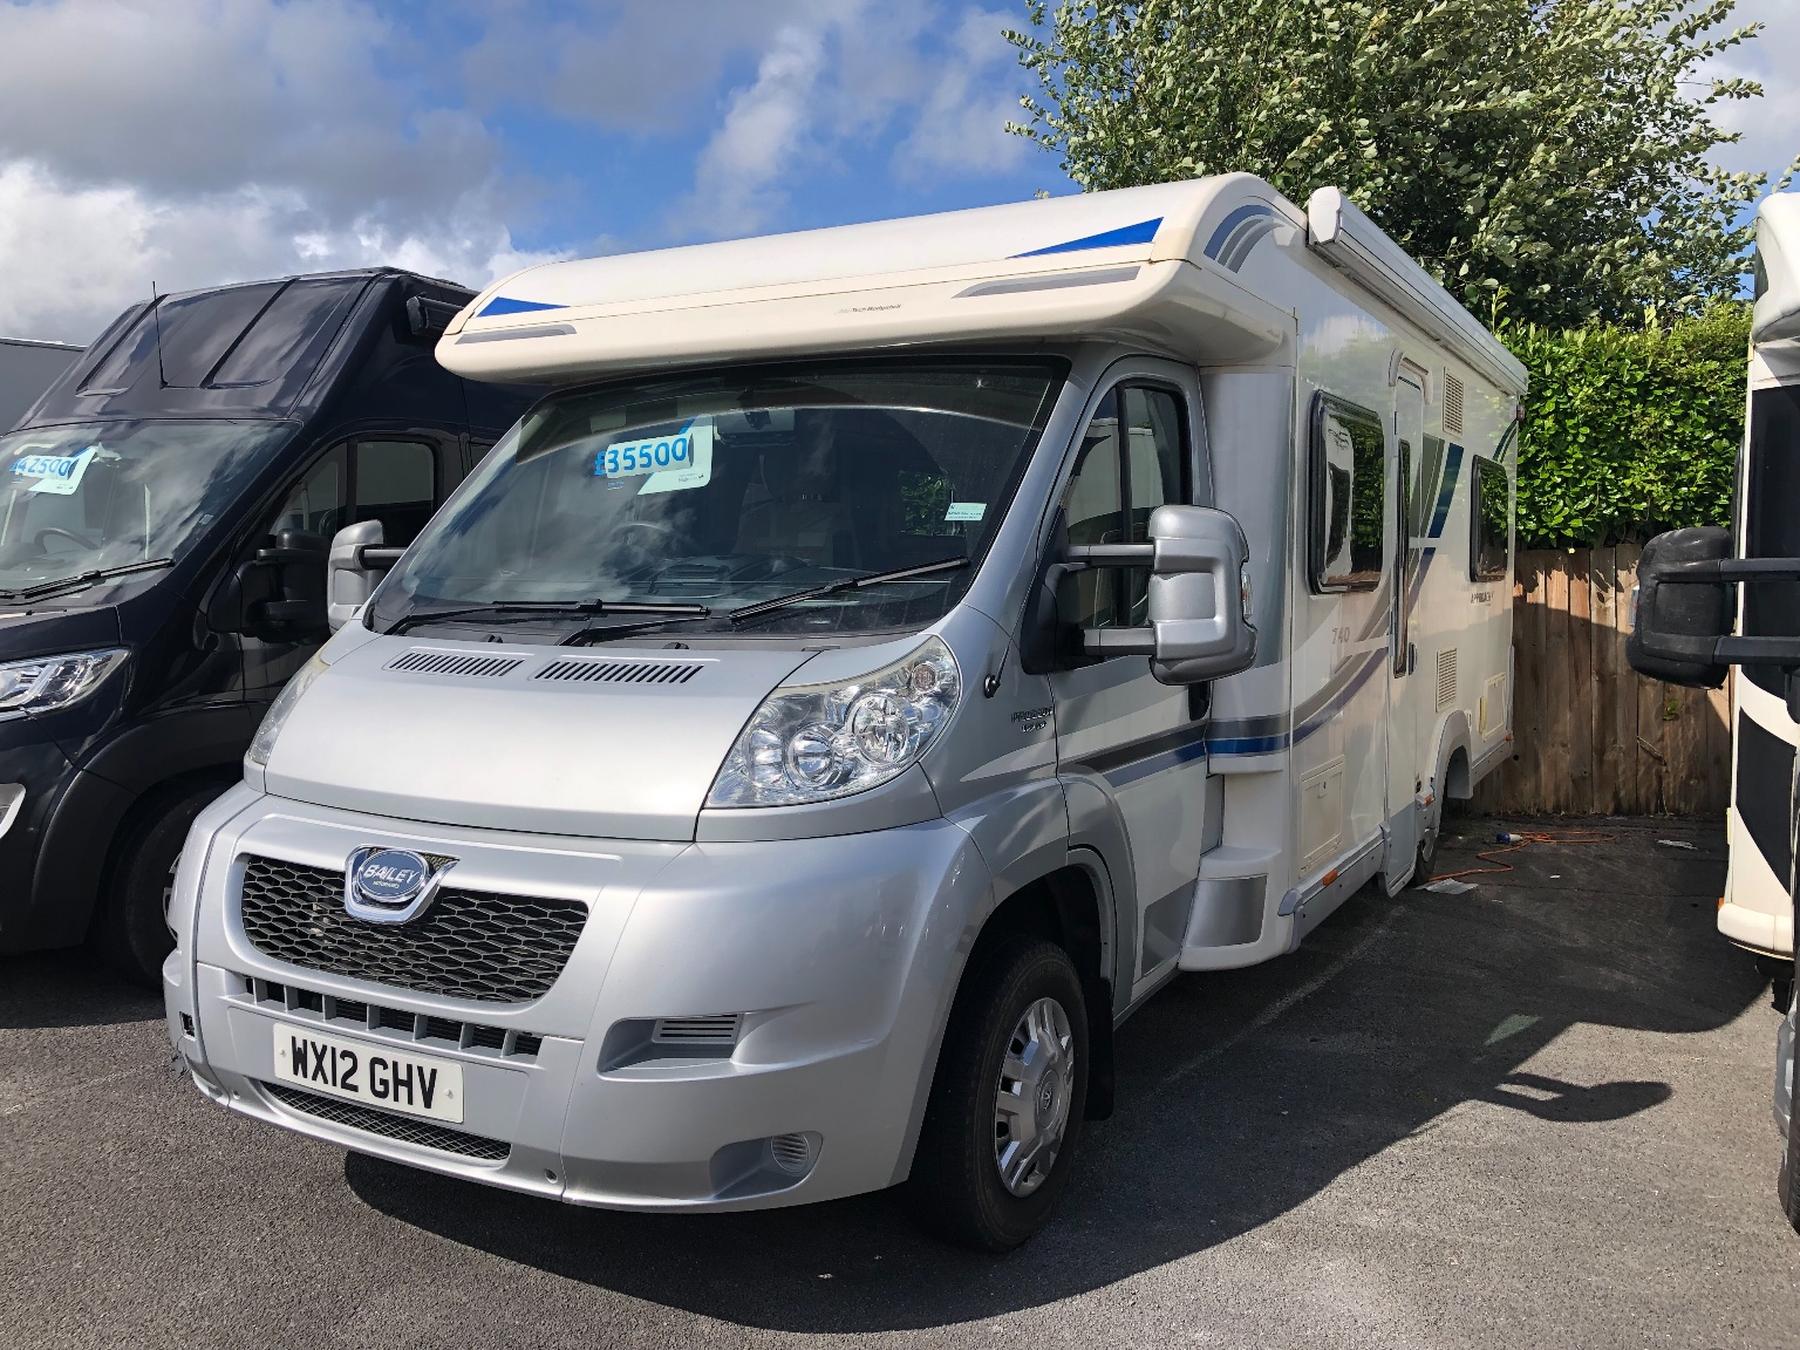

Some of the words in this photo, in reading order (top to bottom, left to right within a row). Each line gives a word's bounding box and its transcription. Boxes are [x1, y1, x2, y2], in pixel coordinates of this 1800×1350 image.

[363, 864, 420, 884] BAILEY
[291, 1035, 359, 1093] WX12
[369, 1056, 438, 1109] GHV
